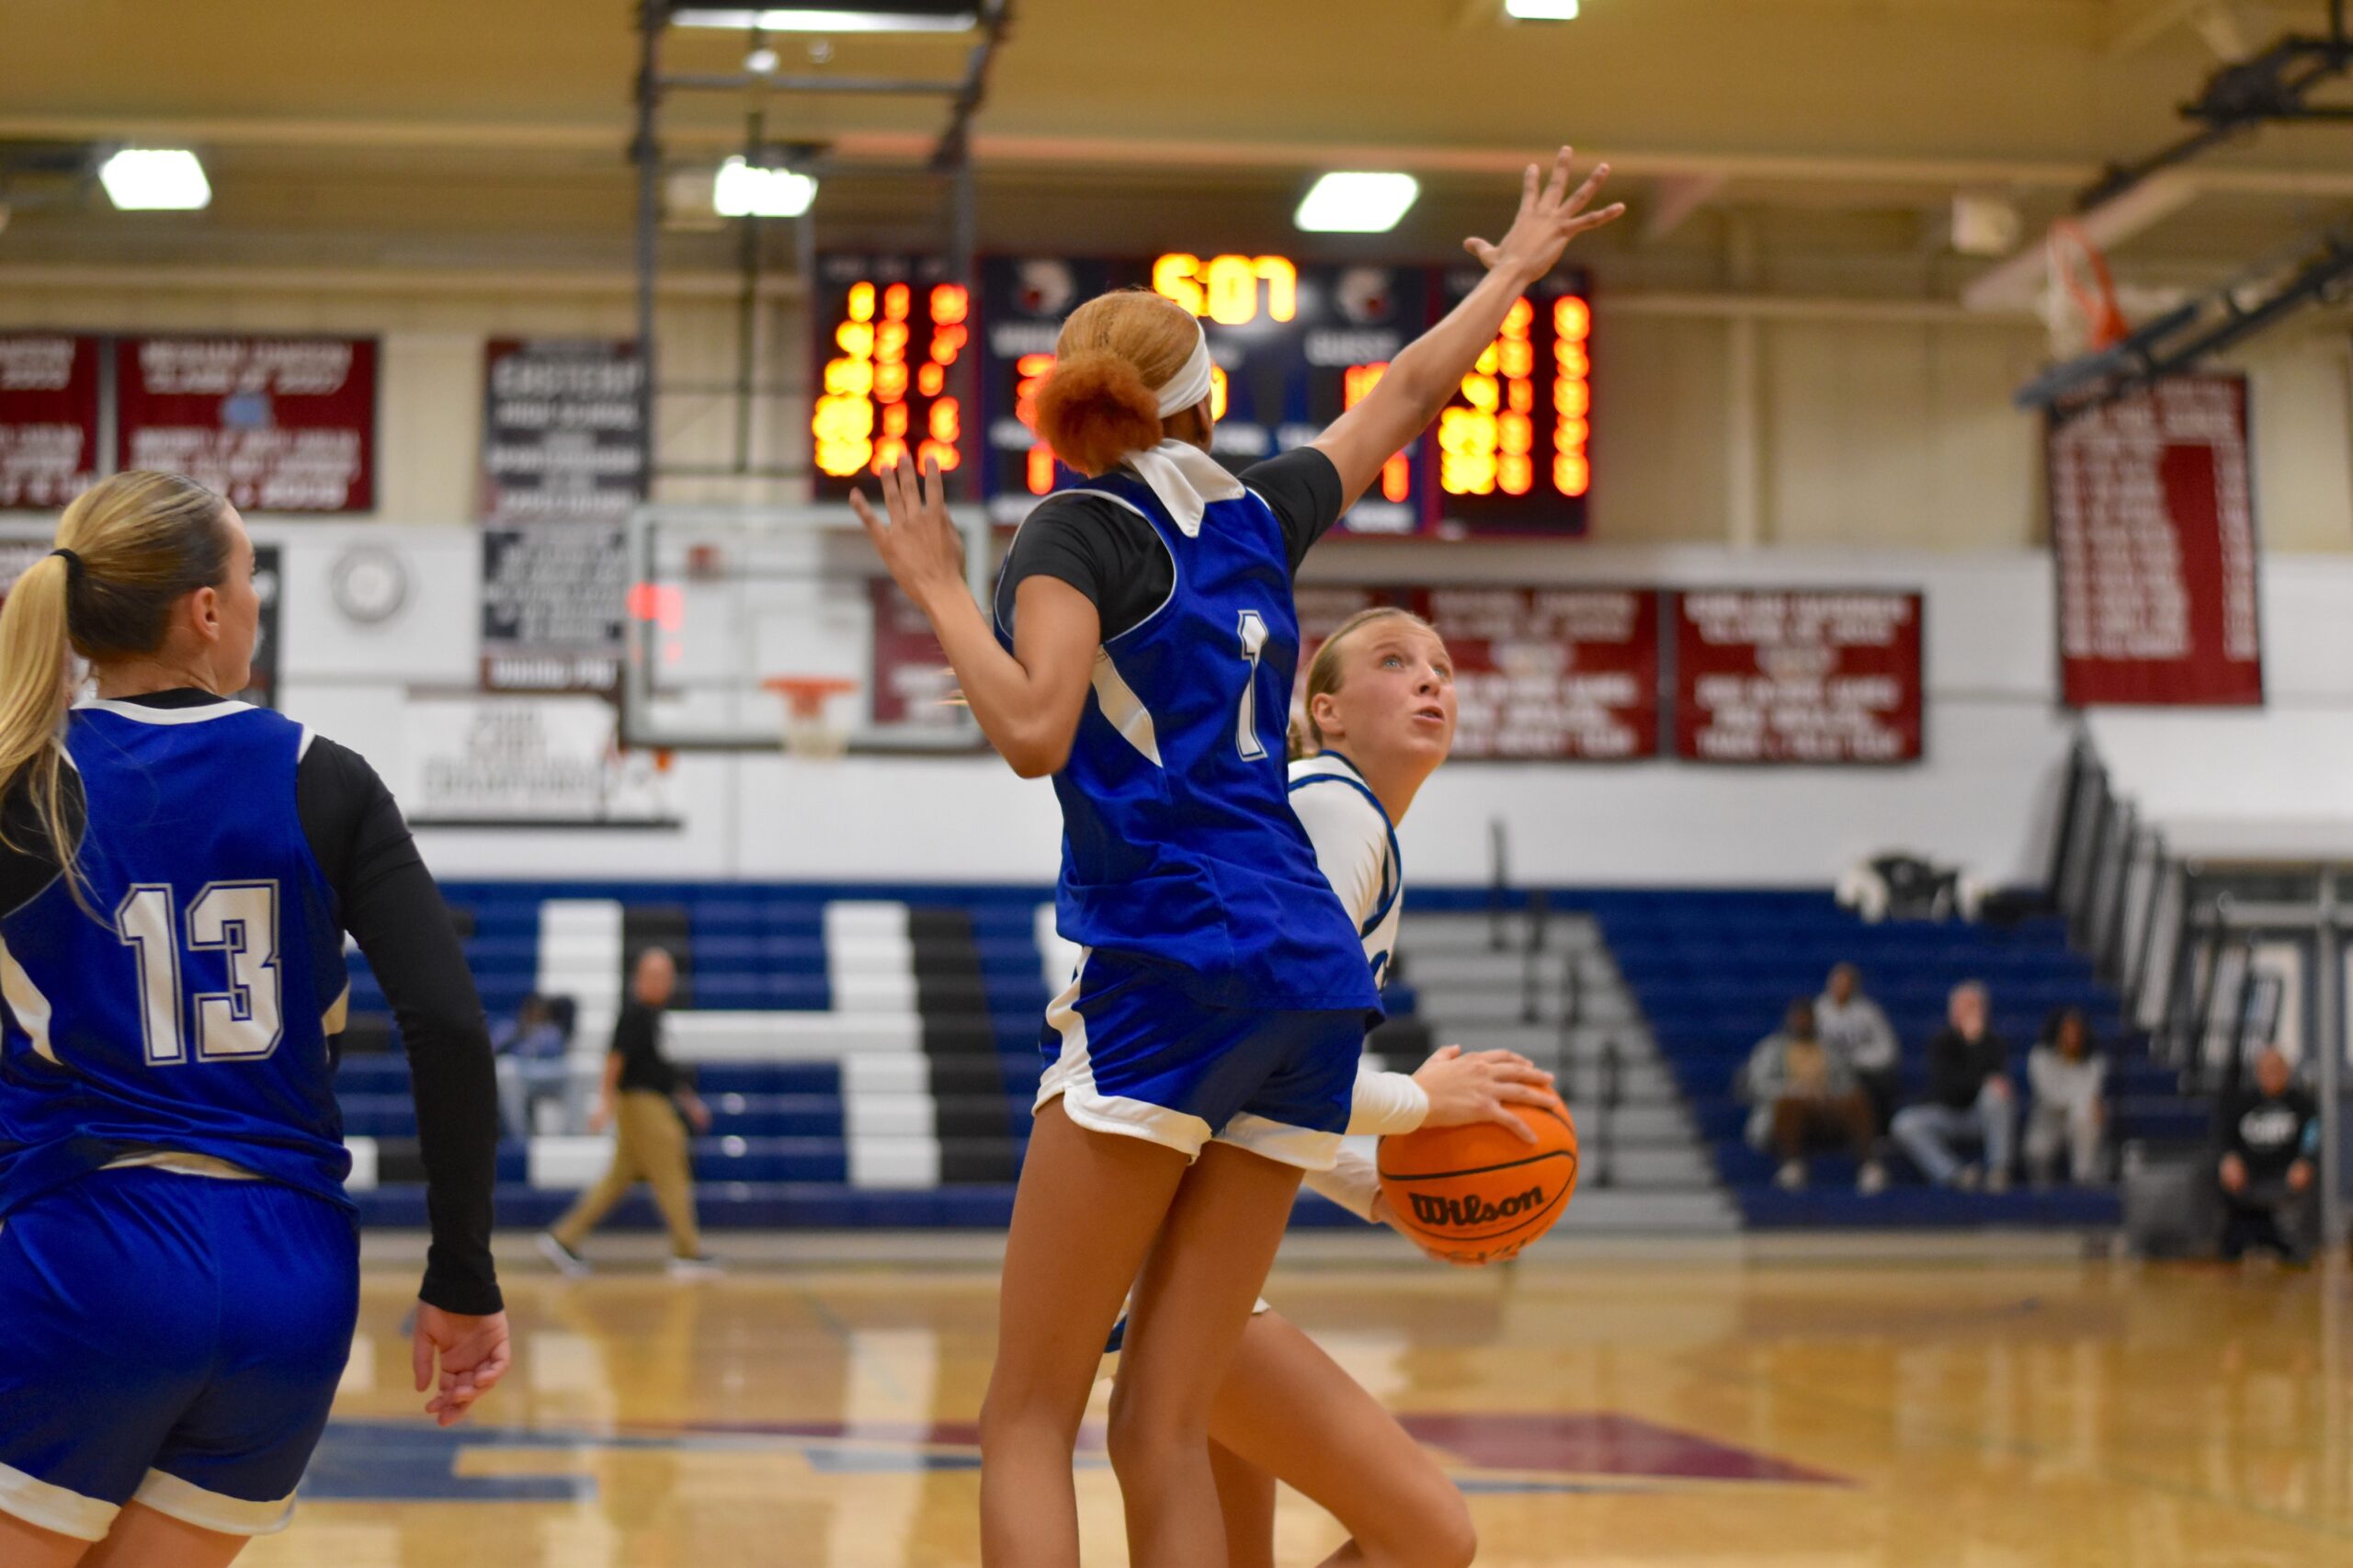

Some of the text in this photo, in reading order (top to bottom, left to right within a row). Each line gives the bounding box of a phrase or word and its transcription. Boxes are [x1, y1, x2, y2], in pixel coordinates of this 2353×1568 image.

[1237, 609, 1268, 761] 1
[115, 879, 284, 1066] 13
[1408, 1186, 1544, 1225] Wilson
